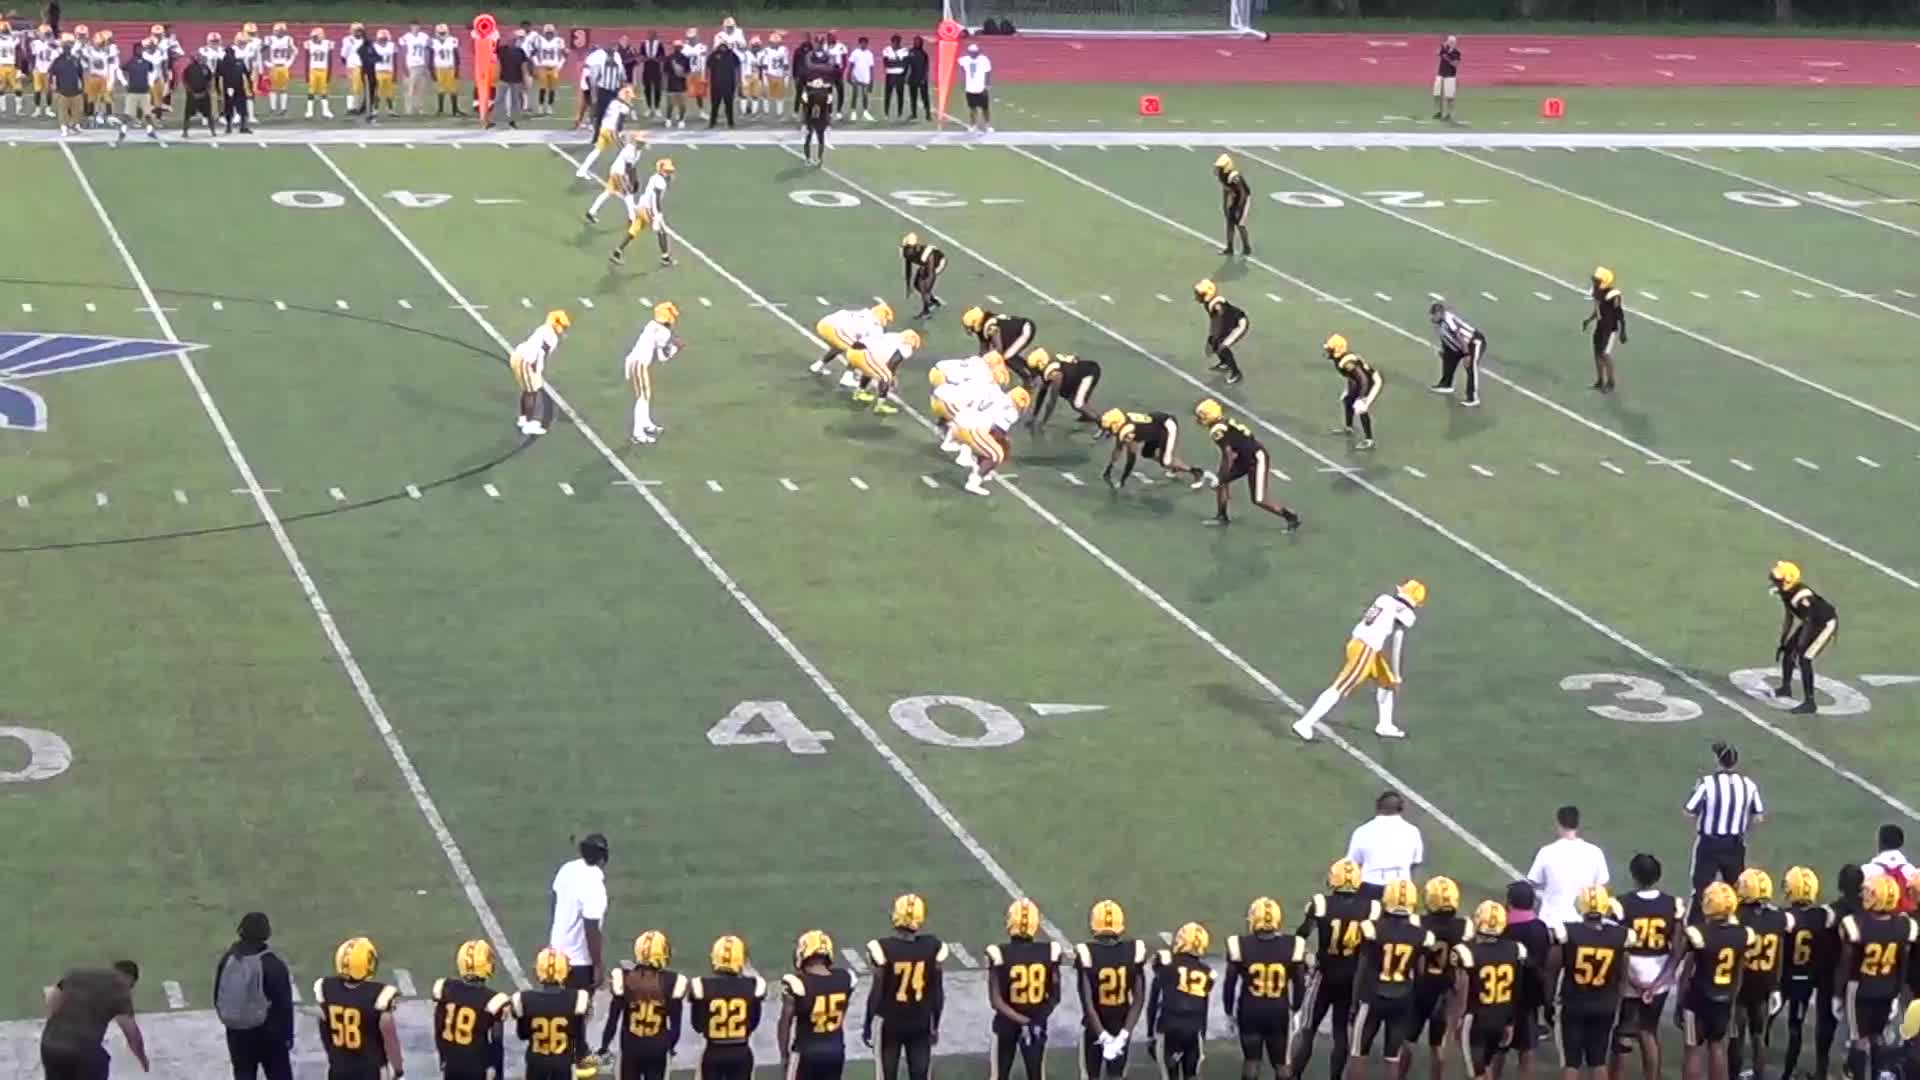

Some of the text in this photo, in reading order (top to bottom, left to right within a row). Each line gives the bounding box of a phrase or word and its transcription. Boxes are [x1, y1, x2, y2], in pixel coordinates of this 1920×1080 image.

[1328, 918, 1361, 957] 14
[1633, 917, 1667, 949] 76
[1744, 933, 1778, 971] 23
[1793, 929, 1812, 965] 6
[1379, 943, 1413, 982] 17
[1574, 946, 1615, 986] 57
[1714, 947, 1734, 985] 2
[1860, 942, 1897, 976] 24
[893, 961, 926, 1002] 74
[1009, 963, 1047, 1004] 28
[1098, 967, 1127, 1007] 21
[1176, 966, 1208, 997] 12
[1249, 962, 1286, 998] 30
[1479, 963, 1514, 1005] 32
[328, 1006, 361, 1048] 58
[441, 1003, 475, 1045] 18
[629, 1002, 662, 1037] 25
[709, 999, 747, 1039] 22
[810, 993, 847, 1033] 45
[531, 1017, 568, 1055] 26
